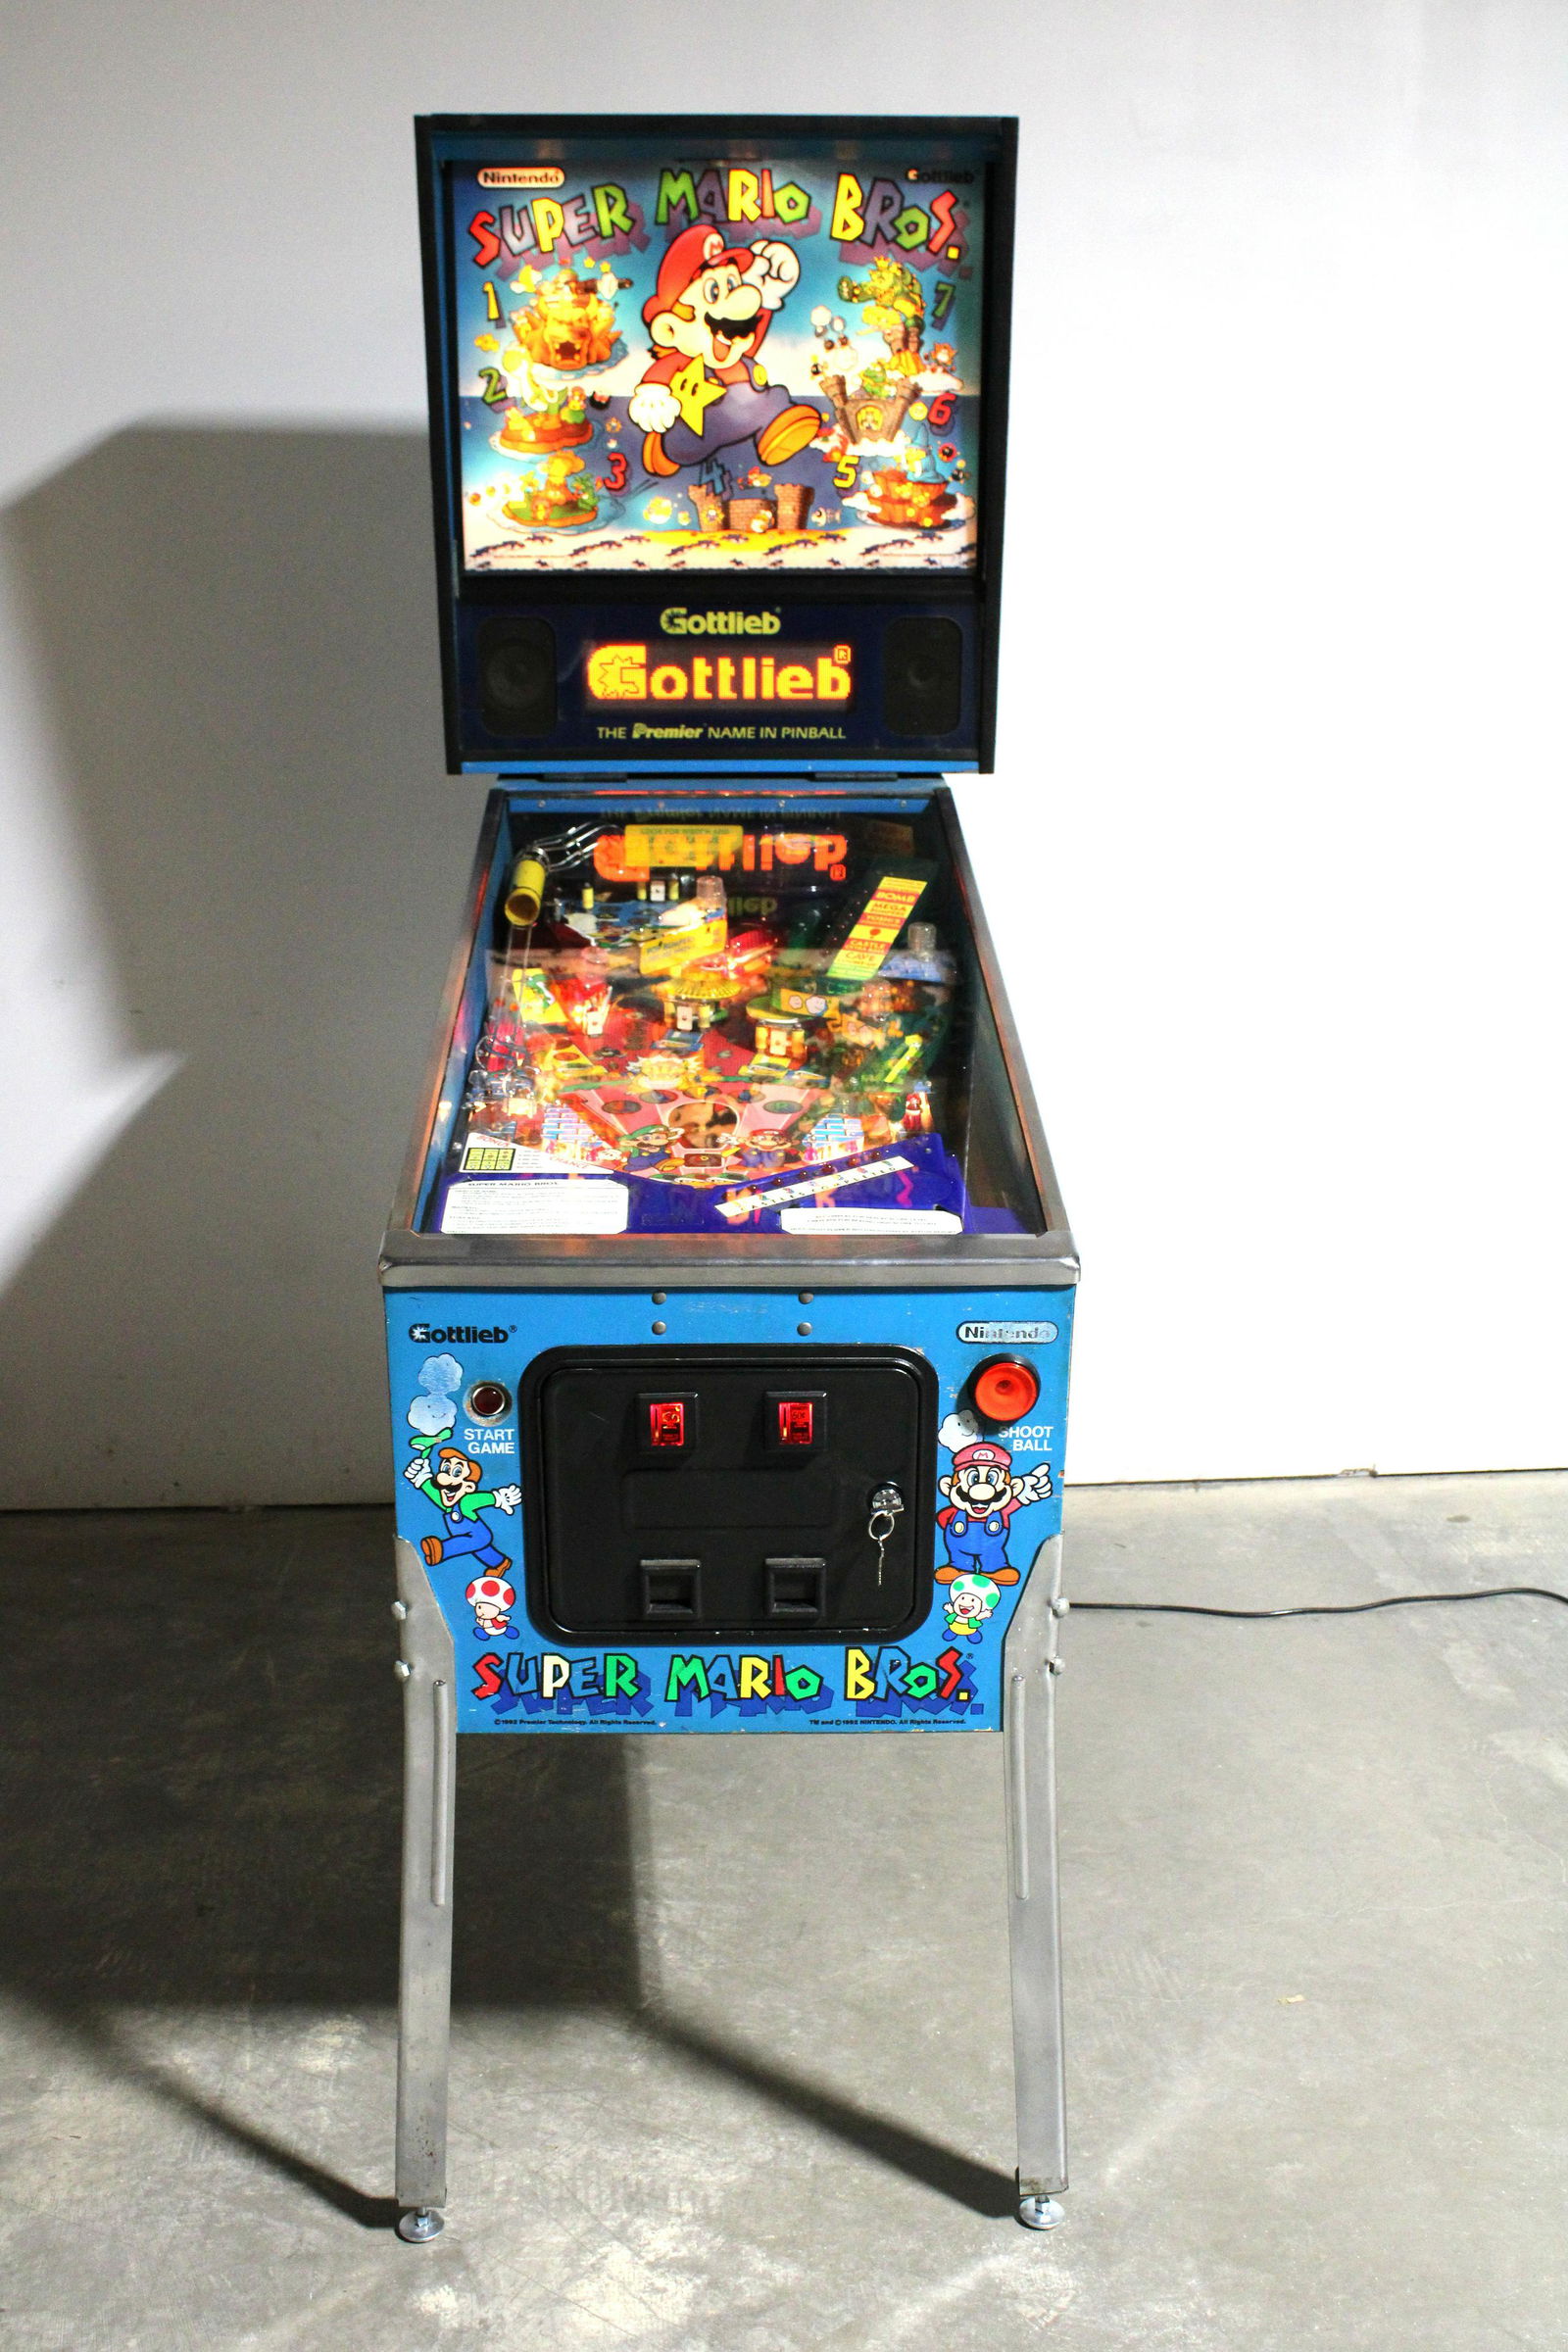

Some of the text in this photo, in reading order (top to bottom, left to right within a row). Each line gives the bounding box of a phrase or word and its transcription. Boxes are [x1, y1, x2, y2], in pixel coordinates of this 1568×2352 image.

[483, 170, 560, 184] Nintendo
[467, 182, 635, 269] SUPER
[655, 168, 811, 226] MARIO
[660, 607, 781, 634] Gottlieb
[597, 722, 846, 739] THE Premier NAME IN PINBALL
[464, 1428, 514, 1441] START
[998, 1426, 1054, 1439] SHOOT
[467, 1442, 514, 1454] GAME
[1012, 1439, 1053, 1451] BALL
[470, 1652, 643, 1701] SUPER
[663, 1653, 824, 1702] MARIO
